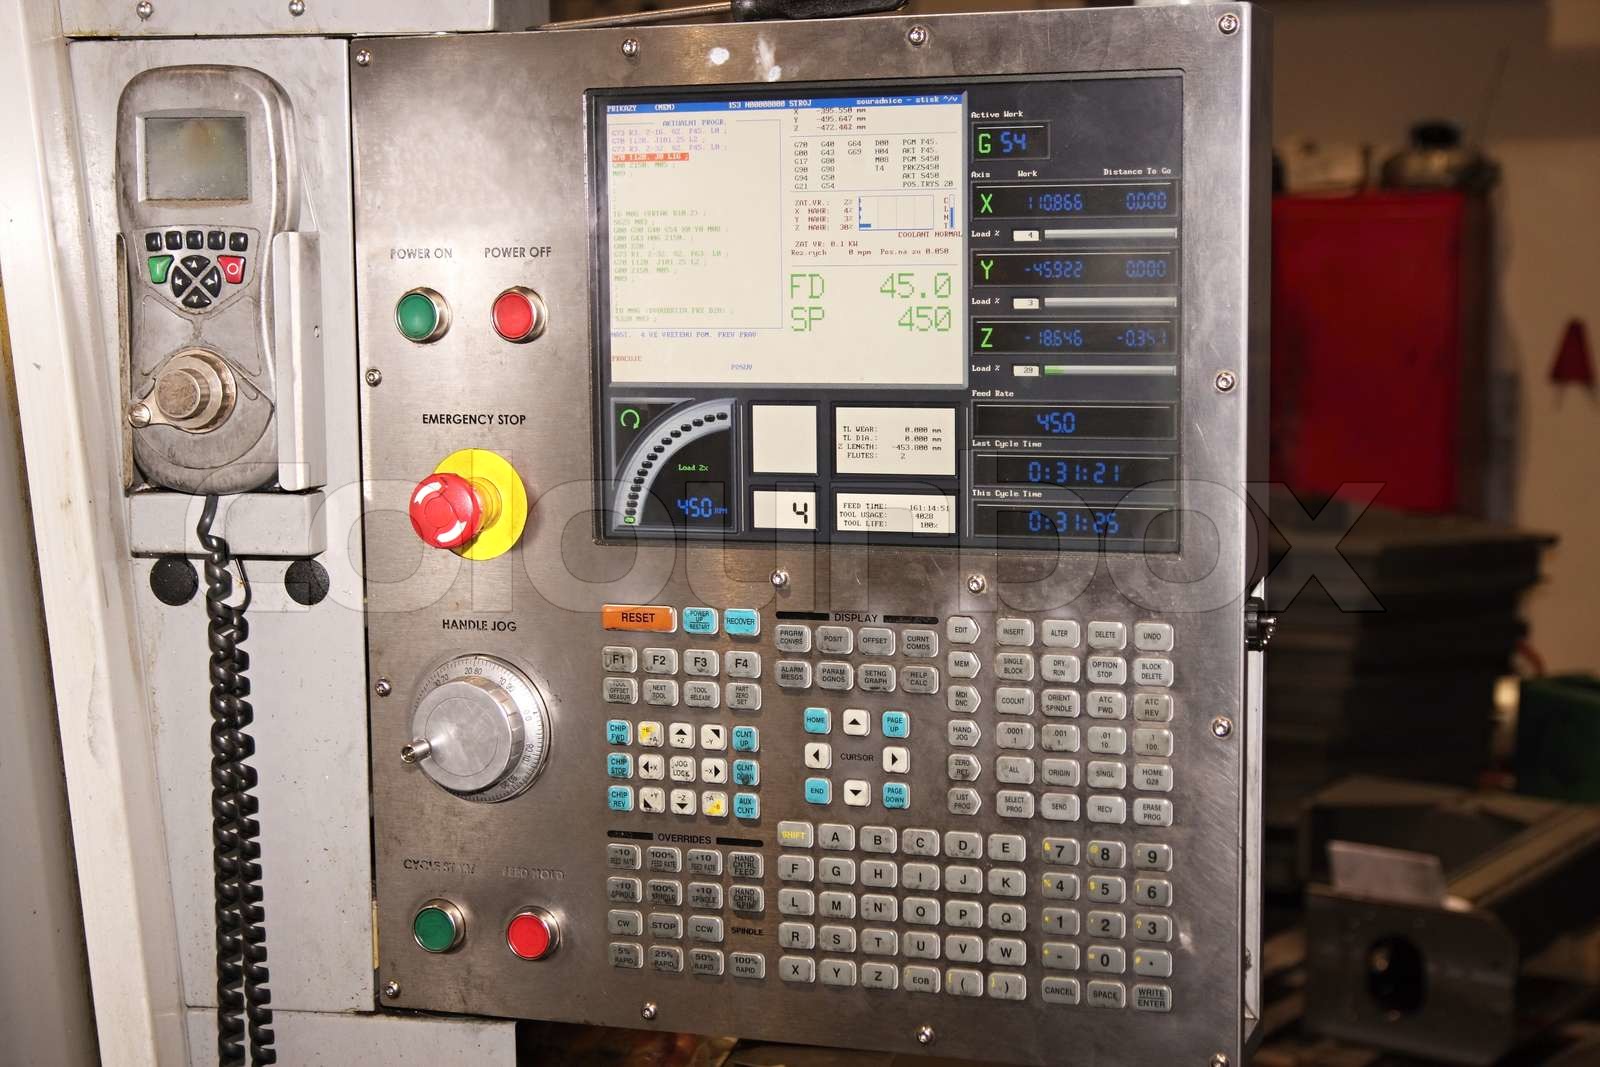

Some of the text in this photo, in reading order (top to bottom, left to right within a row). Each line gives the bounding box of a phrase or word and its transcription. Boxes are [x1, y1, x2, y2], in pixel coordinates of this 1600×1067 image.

[971, 110, 1023, 119] Active Work
[978, 131, 1028, 154] G 54
[1103, 168, 1143, 176] Distance
[1161, 167, 1171, 175] Go
[980, 193, 993, 214] X
[390, 248, 453, 260] POWER ON
[485, 246, 552, 258] POWER OFF
[980, 260, 994, 280] Y
[790, 272, 952, 299] FD 45.0
[791, 306, 952, 332] SP 450
[981, 328, 993, 348] Z
[422, 414, 526, 425] EMERGENCY STOP
[995, 440, 1019, 448] Cycle
[1029, 461, 1120, 483] 0:31:21
[995, 490, 1019, 499] Cycle
[677, 497, 713, 518] 450
[792, 502, 808, 525] 4
[1029, 511, 1120, 534] 0:31:25
[621, 612, 655, 623] RESET
[834, 613, 878, 623] DISPLAY
[442, 619, 517, 632] HANDLE JOG
[1003, 628, 1025, 636] INSERT
[1095, 631, 1116, 639] DELETE
[1143, 632, 1161, 640] UNDO
[823, 635, 843, 643] POSIT
[862, 637, 888, 645] OFFSET
[906, 635, 929, 643] CURNT
[612, 654, 625, 664] F1
[653, 655, 666, 666] F2
[694, 657, 708, 667] F3
[735, 658, 748, 669] F4
[1092, 661, 1118, 669] OPTION
[735, 730, 752, 738] CLNT
[956, 733, 969, 741] JOG
[840, 753, 874, 762] CURSOR
[674, 760, 688, 768] JOG
[1048, 769, 1071, 777] ORIGIN
[887, 787, 903, 795] PAGE
[613, 800, 626, 808] REV
[657, 833, 712, 844] OVERRIDES
[831, 832, 840, 842] A
[873, 835, 882, 845] B
[916, 838, 925, 848] C
[959, 840, 968, 851] D
[1002, 842, 1010, 853] E
[651, 851, 674, 859] 100%
[1055, 845, 1065, 858] 7
[1100, 848, 1110, 861] 8
[1148, 850, 1157, 863] 9
[734, 855, 755, 863] HAND
[792, 863, 799, 874] F
[832, 866, 841, 877] G
[874, 869, 882, 879] H
[960, 874, 967, 885] J
[1002, 877, 1011, 888] K
[652, 884, 675, 892] 100%
[1056, 880, 1065, 892] 4
[1101, 883, 1109, 896] 5
[1148, 886, 1157, 899] 6
[792, 897, 798, 907] L
[831, 901, 842, 911] M
[874, 902, 882, 913] N
[916, 906, 926, 917] O
[959, 909, 968, 919] P
[1002, 912, 1012, 923] Q
[652, 922, 676, 930] STOP
[1057, 916, 1063, 928] 1
[1101, 919, 1110, 932] 2
[695, 925, 714, 933] CCW
[731, 927, 764, 936] SPINDLE
[1148, 922, 1157, 935] 3
[792, 932, 800, 942] R
[832, 934, 841, 945] S
[875, 937, 883, 948] T
[917, 941, 925, 951] U
[959, 944, 967, 954] V
[1000, 947, 1012, 958] W
[734, 957, 758, 965] 100%
[1100, 954, 1110, 967] 0
[735, 966, 756, 974] RAPID
[791, 964, 800, 975] X
[832, 968, 841, 978] Y
[875, 971, 882, 981] Z
[912, 976, 929, 985] EOB
[1045, 987, 1075, 997] CANCEL
[1093, 991, 1118, 1000] SPACE
[1138, 989, 1165, 997] WRITE
[1138, 1000, 1166, 1009] ENTER
